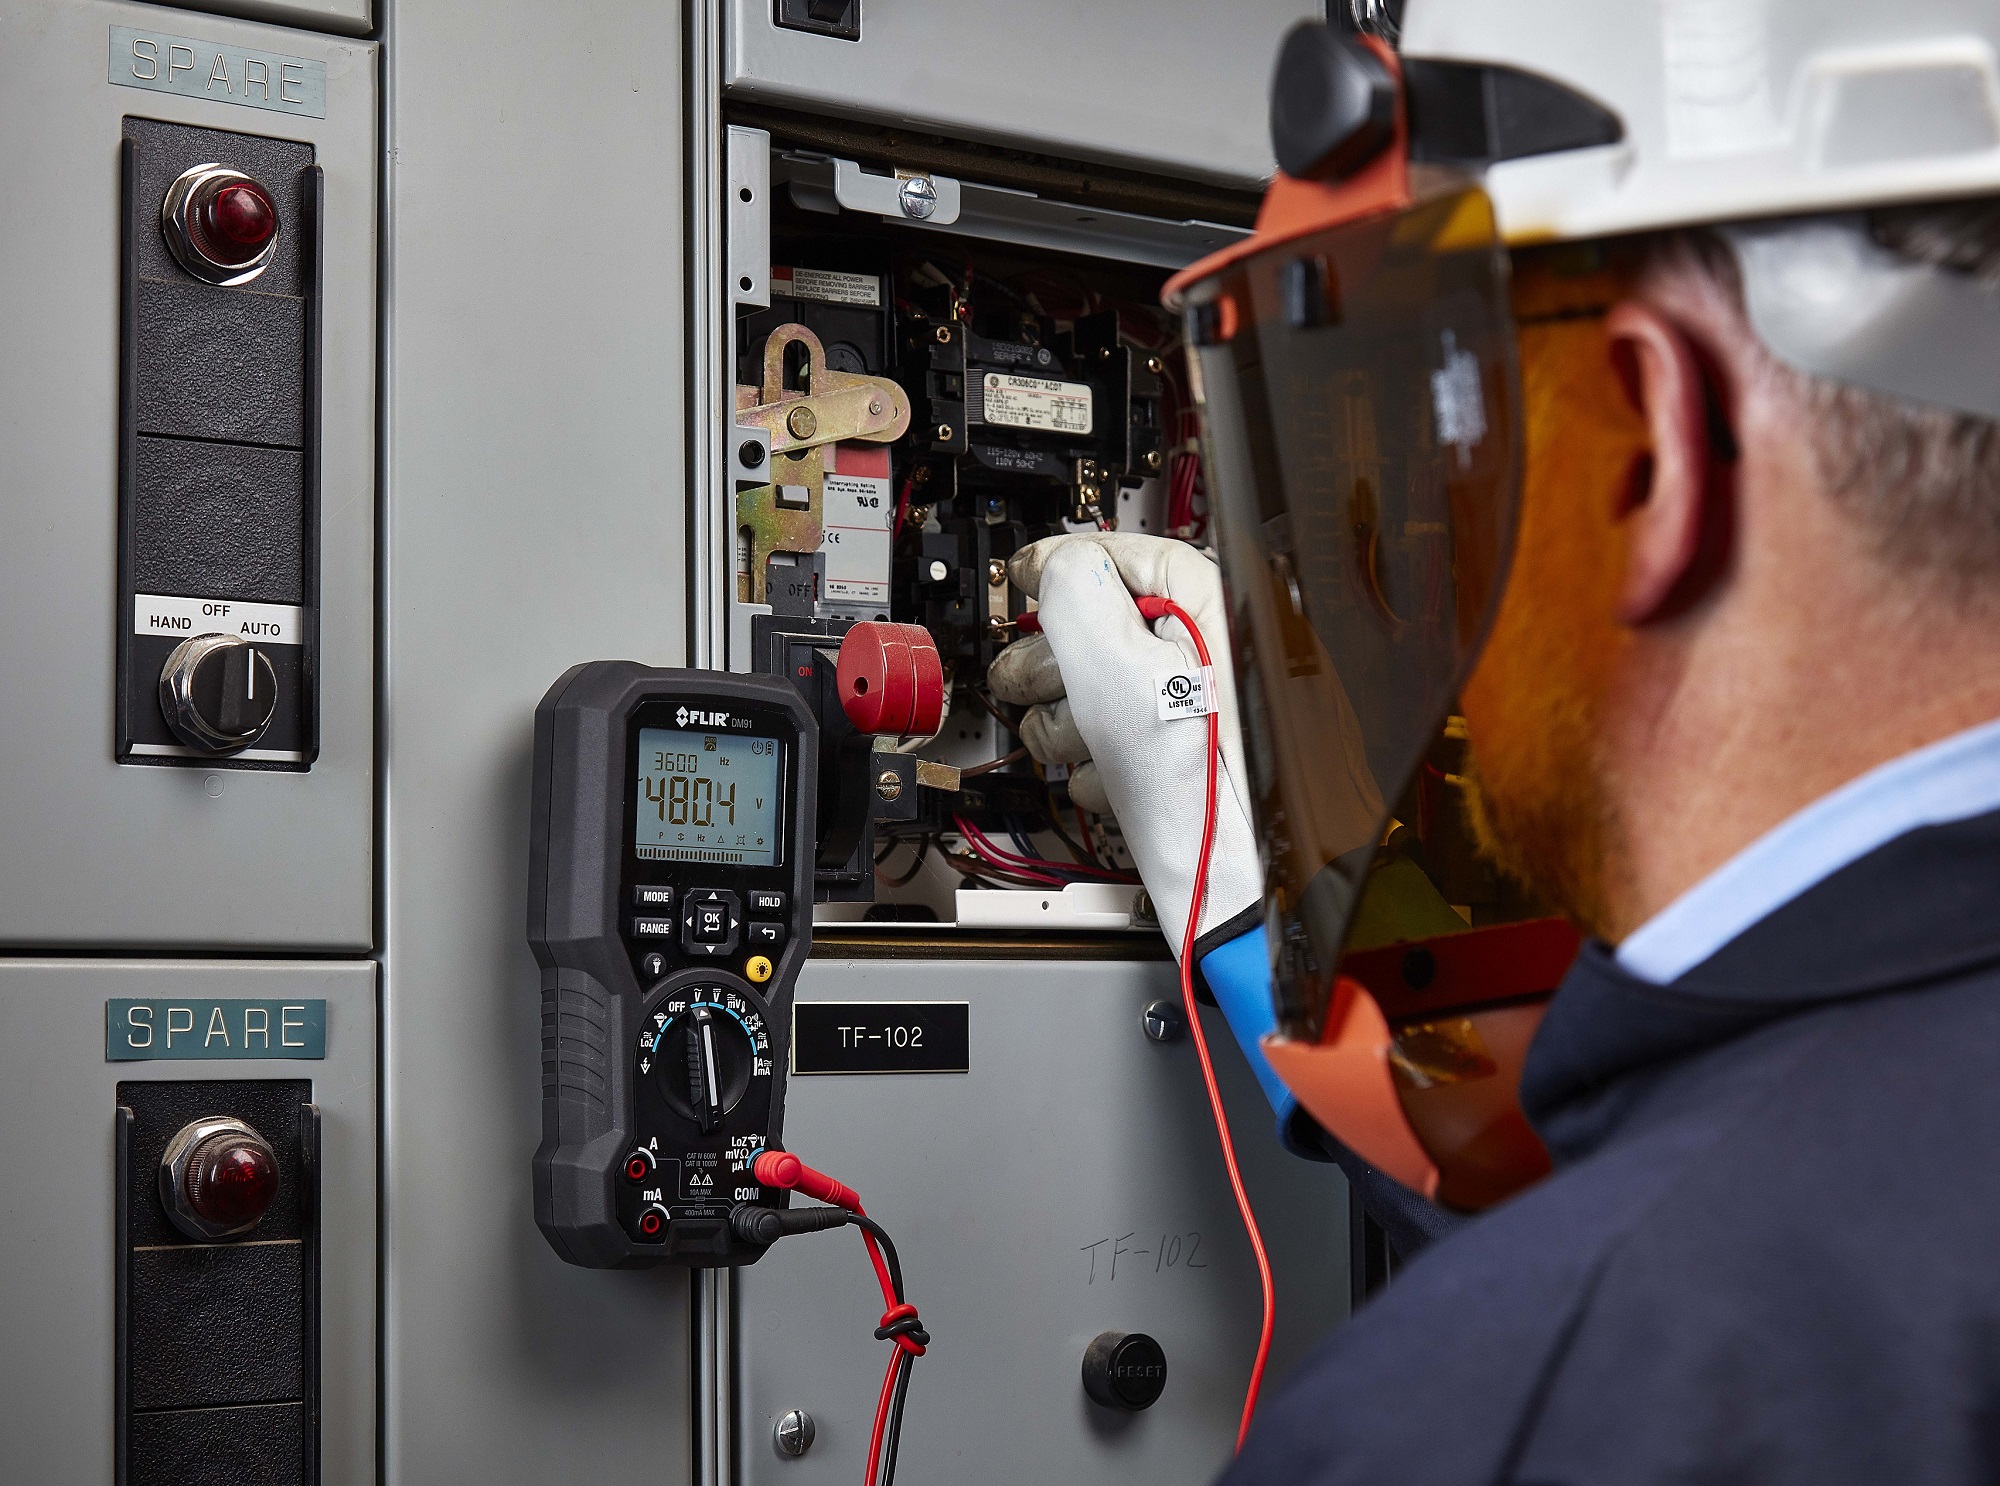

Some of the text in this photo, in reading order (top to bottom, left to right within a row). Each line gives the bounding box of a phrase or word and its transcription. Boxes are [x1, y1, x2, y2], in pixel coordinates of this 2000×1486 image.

[131, 38, 304, 104] SPARE
[795, 270, 832, 280] DE-ENERGIZE
[843, 275, 863, 284] POWER
[795, 278, 876, 292] BEFORE REMOVING BARRIERS
[795, 285, 871, 298] REPLACE BARRIERS BEFORE
[788, 583, 811, 598] OFF
[202, 603, 231, 617] OFF
[150, 615, 192, 630] HAND
[240, 621, 281, 636] AUTO
[797, 666, 813, 677] ON
[1168, 699, 1194, 708] LISTED
[689, 710, 752, 729] FLIR DM91
[719, 756, 730, 767] Hz
[645, 775, 763, 828] 480.4 V
[658, 831, 706, 843] P Hz
[643, 891, 669, 903] MODE
[758, 896, 781, 908] HOLD
[704, 913, 720, 924] OK
[639, 922, 670, 935] RANGE
[668, 1001, 686, 1012] OFF
[727, 998, 741, 1009] mV
[128, 1006, 305, 1049] SPARE
[640, 1038, 654, 1048] LoZ
[837, 1026, 923, 1048] TF-102
[757, 1058, 764, 1068] A
[758, 1067, 771, 1076] mA
[649, 1136, 658, 1150] A
[731, 1136, 766, 1147] LoZ V
[686, 1152, 697, 1160] CAT
[703, 1152, 717, 1160] 600V
[685, 1160, 696, 1168] CAT
[643, 1187, 662, 1201] mA
[700, 1188, 712, 1196] MAX
[734, 1187, 759, 1201] COM
[1080, 1232, 1208, 1285] TF-102
[1116, 1365, 1163, 1378] RESET
